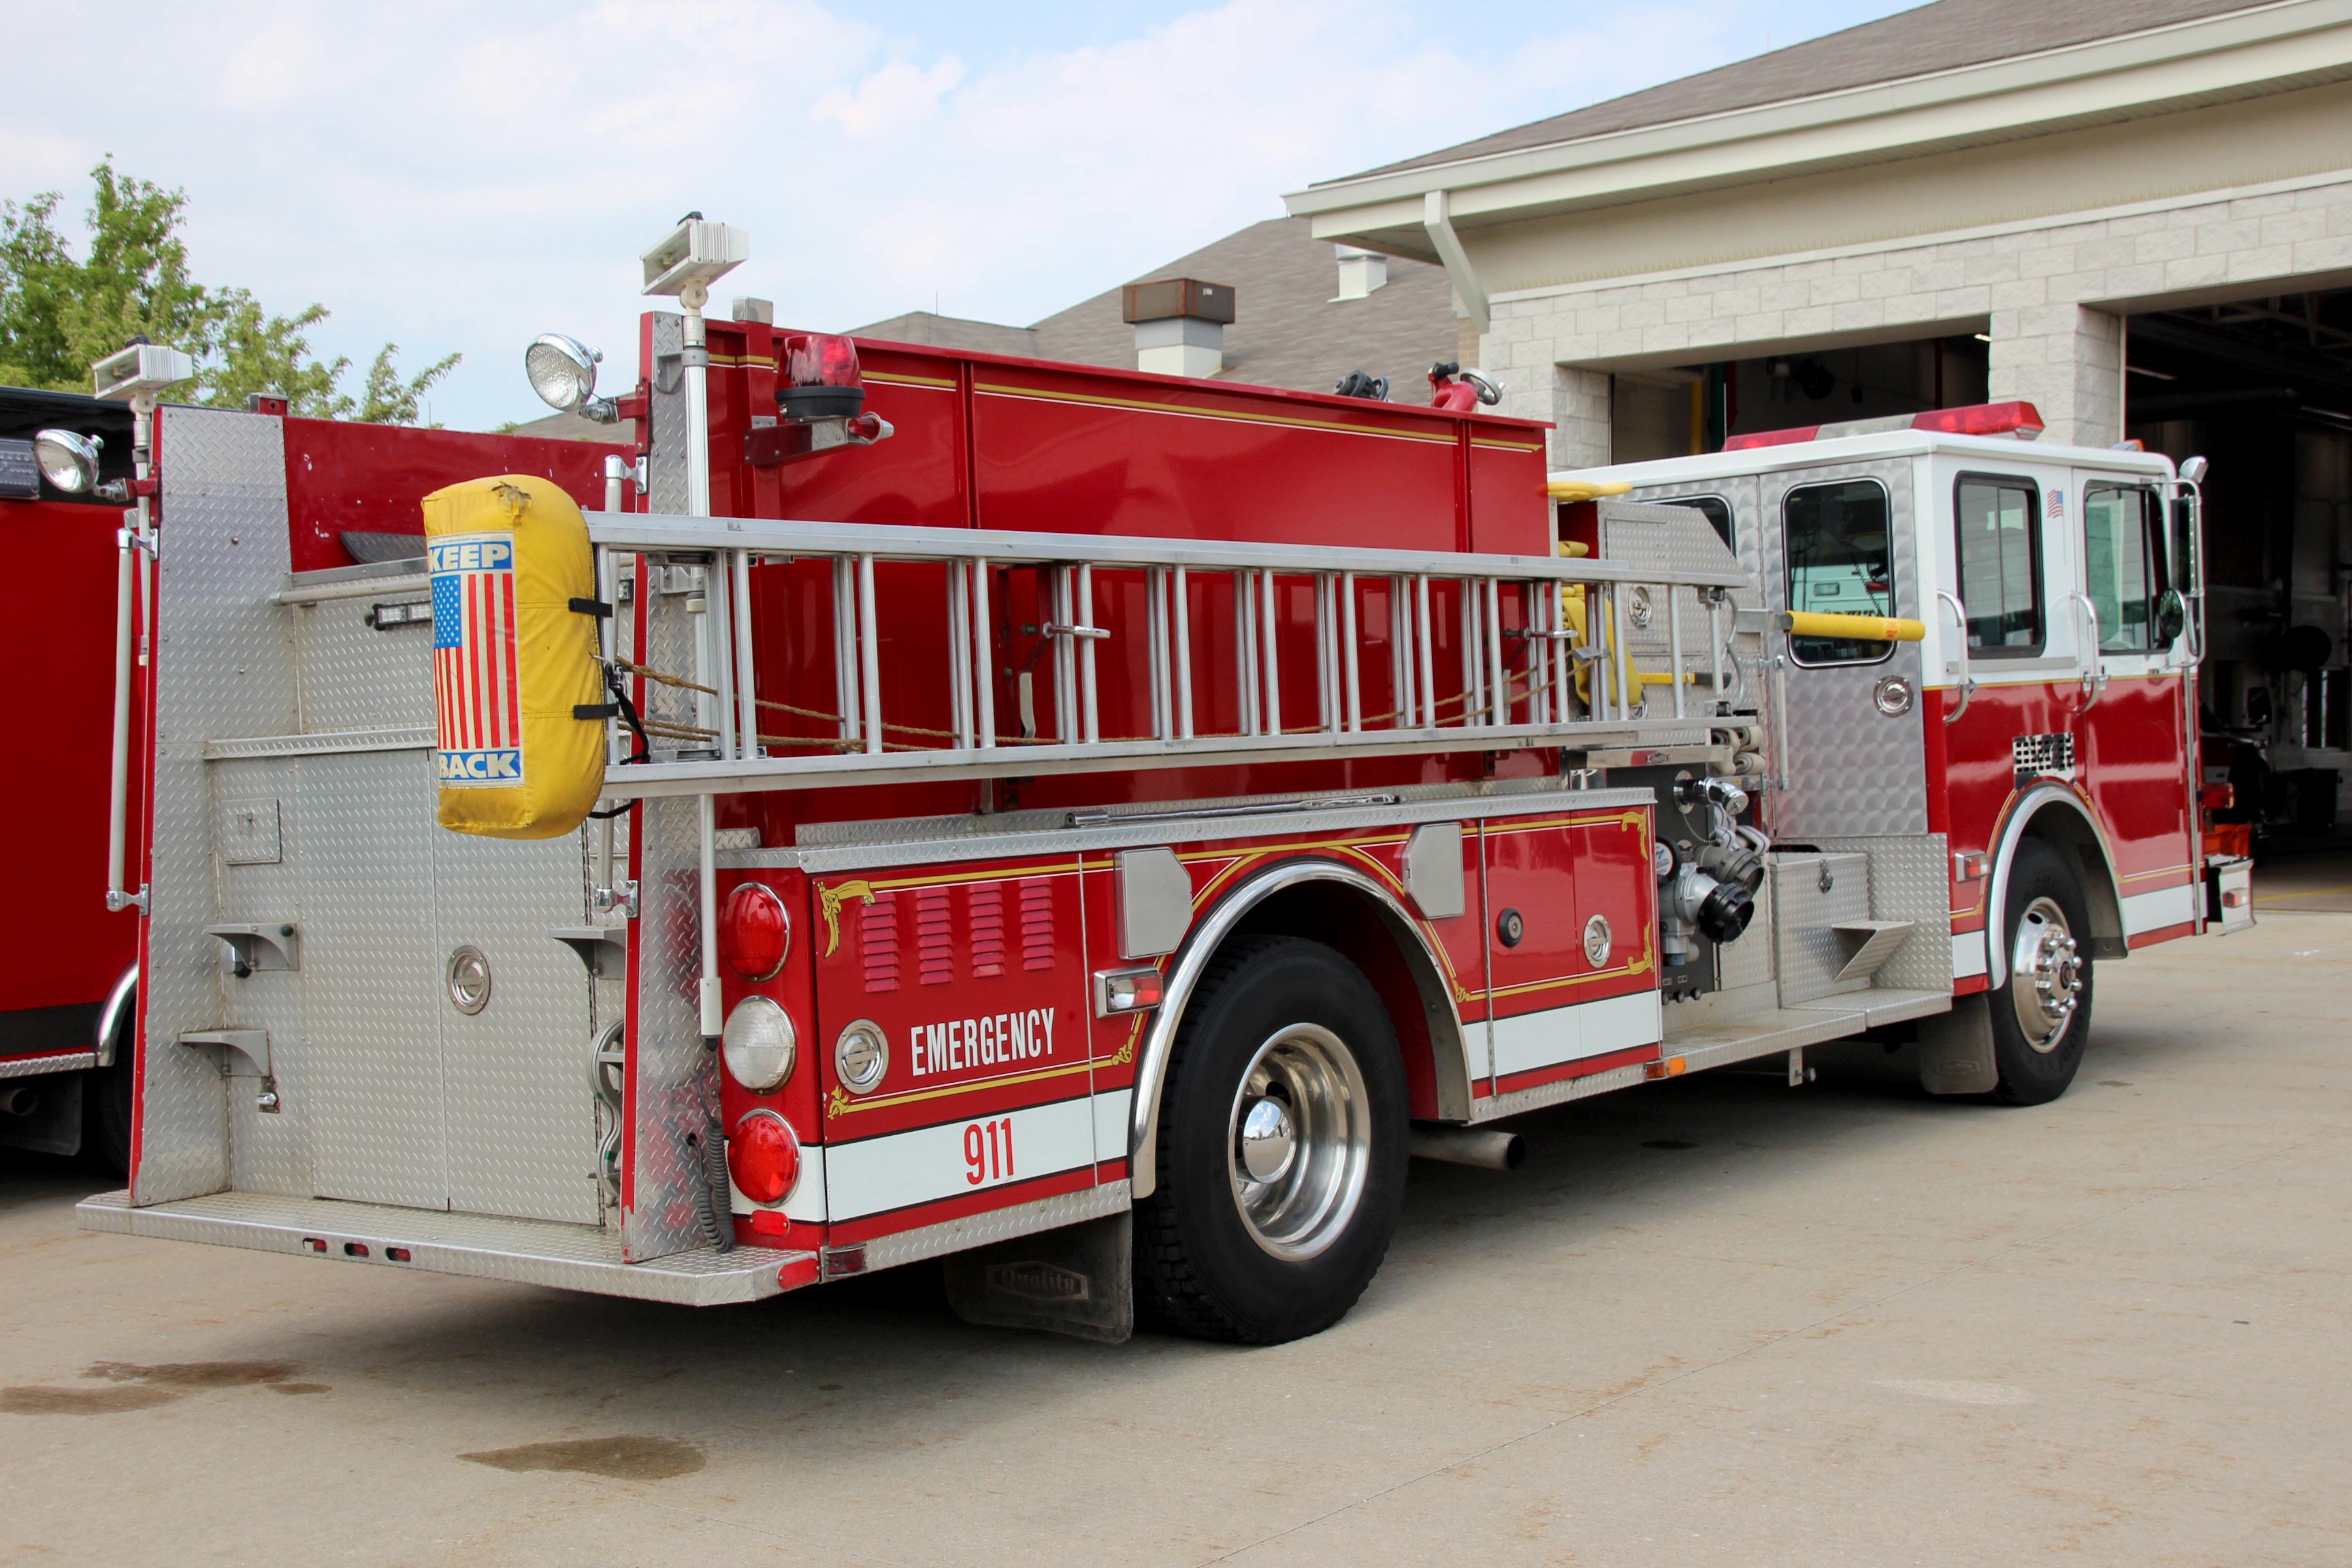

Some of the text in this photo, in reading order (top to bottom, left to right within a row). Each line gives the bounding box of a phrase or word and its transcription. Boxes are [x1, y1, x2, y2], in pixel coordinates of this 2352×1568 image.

[429, 544, 509, 572] KEEP
[439, 753, 517, 779] BACK
[911, 1007, 1054, 1076] EMERGENCY
[964, 1117, 1014, 1185] 911
